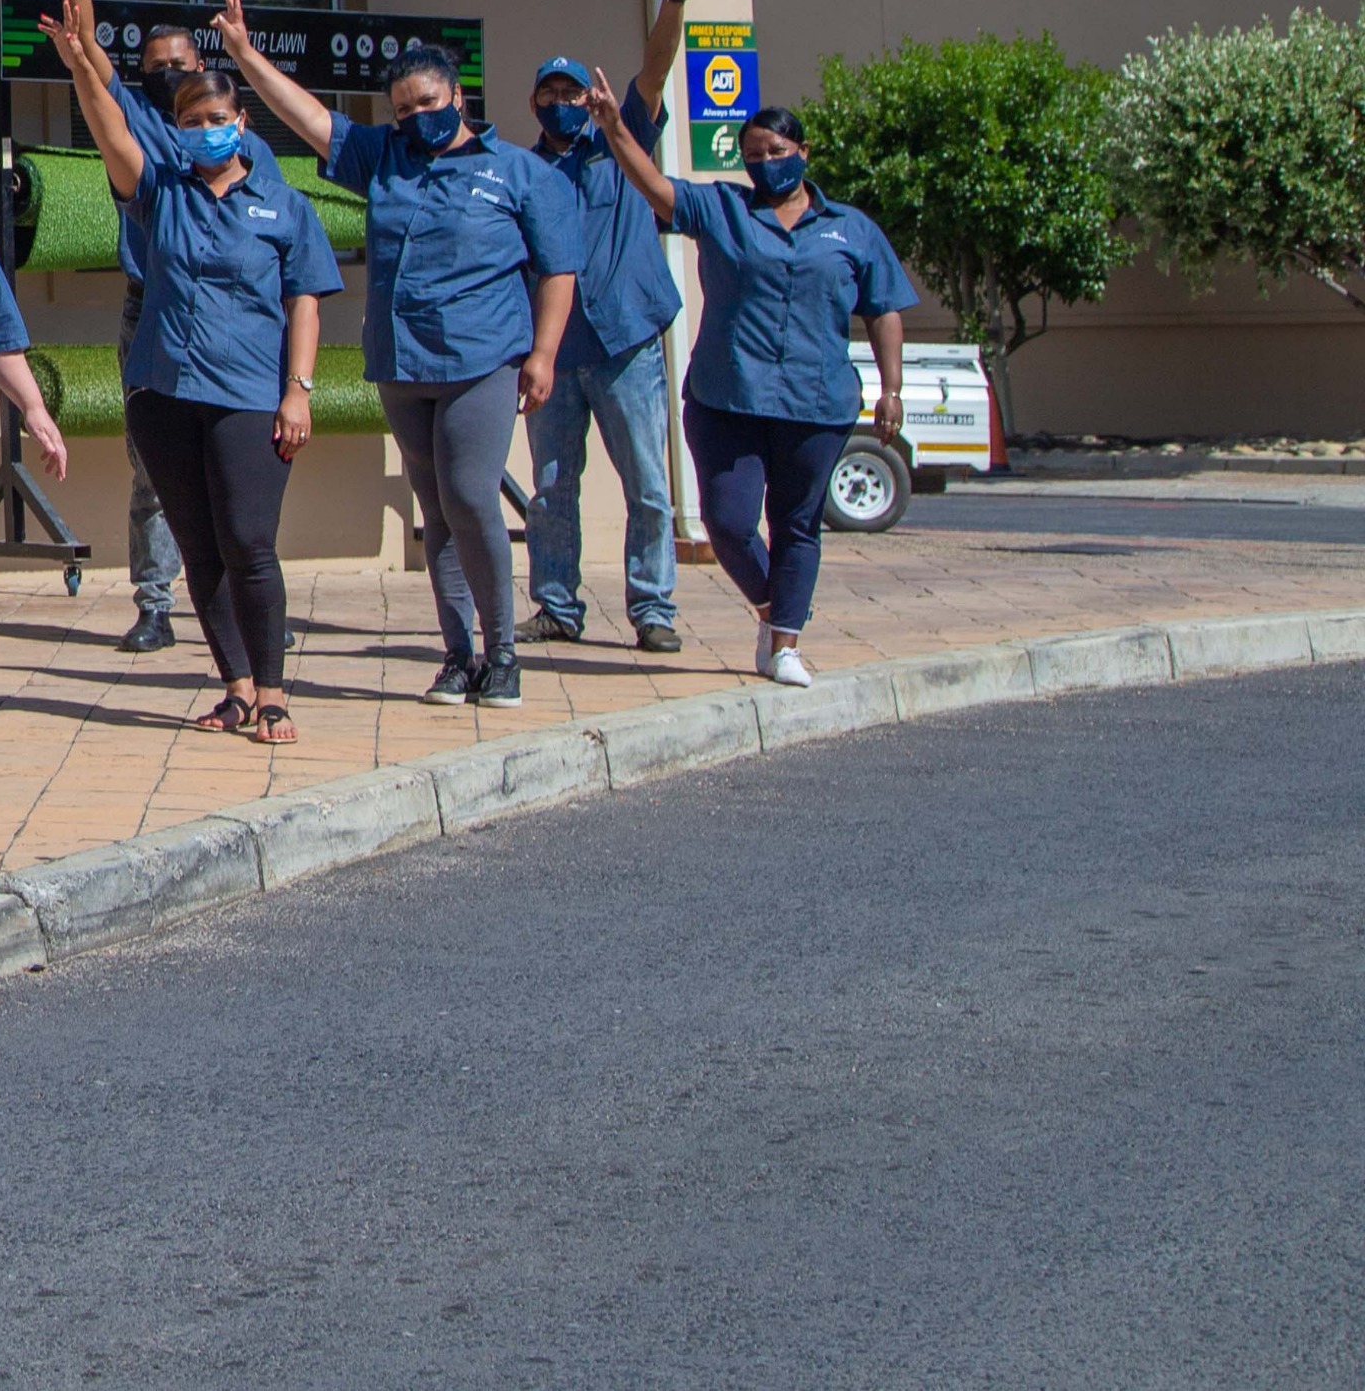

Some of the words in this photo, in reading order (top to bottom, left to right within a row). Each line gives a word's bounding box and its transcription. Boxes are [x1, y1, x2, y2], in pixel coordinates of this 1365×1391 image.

[715, 25, 751, 37] RESPONSE
[270, 32, 307, 55] LAWN
[712, 71, 735, 90] ADT
[909, 414, 955, 424] ROADSTER
